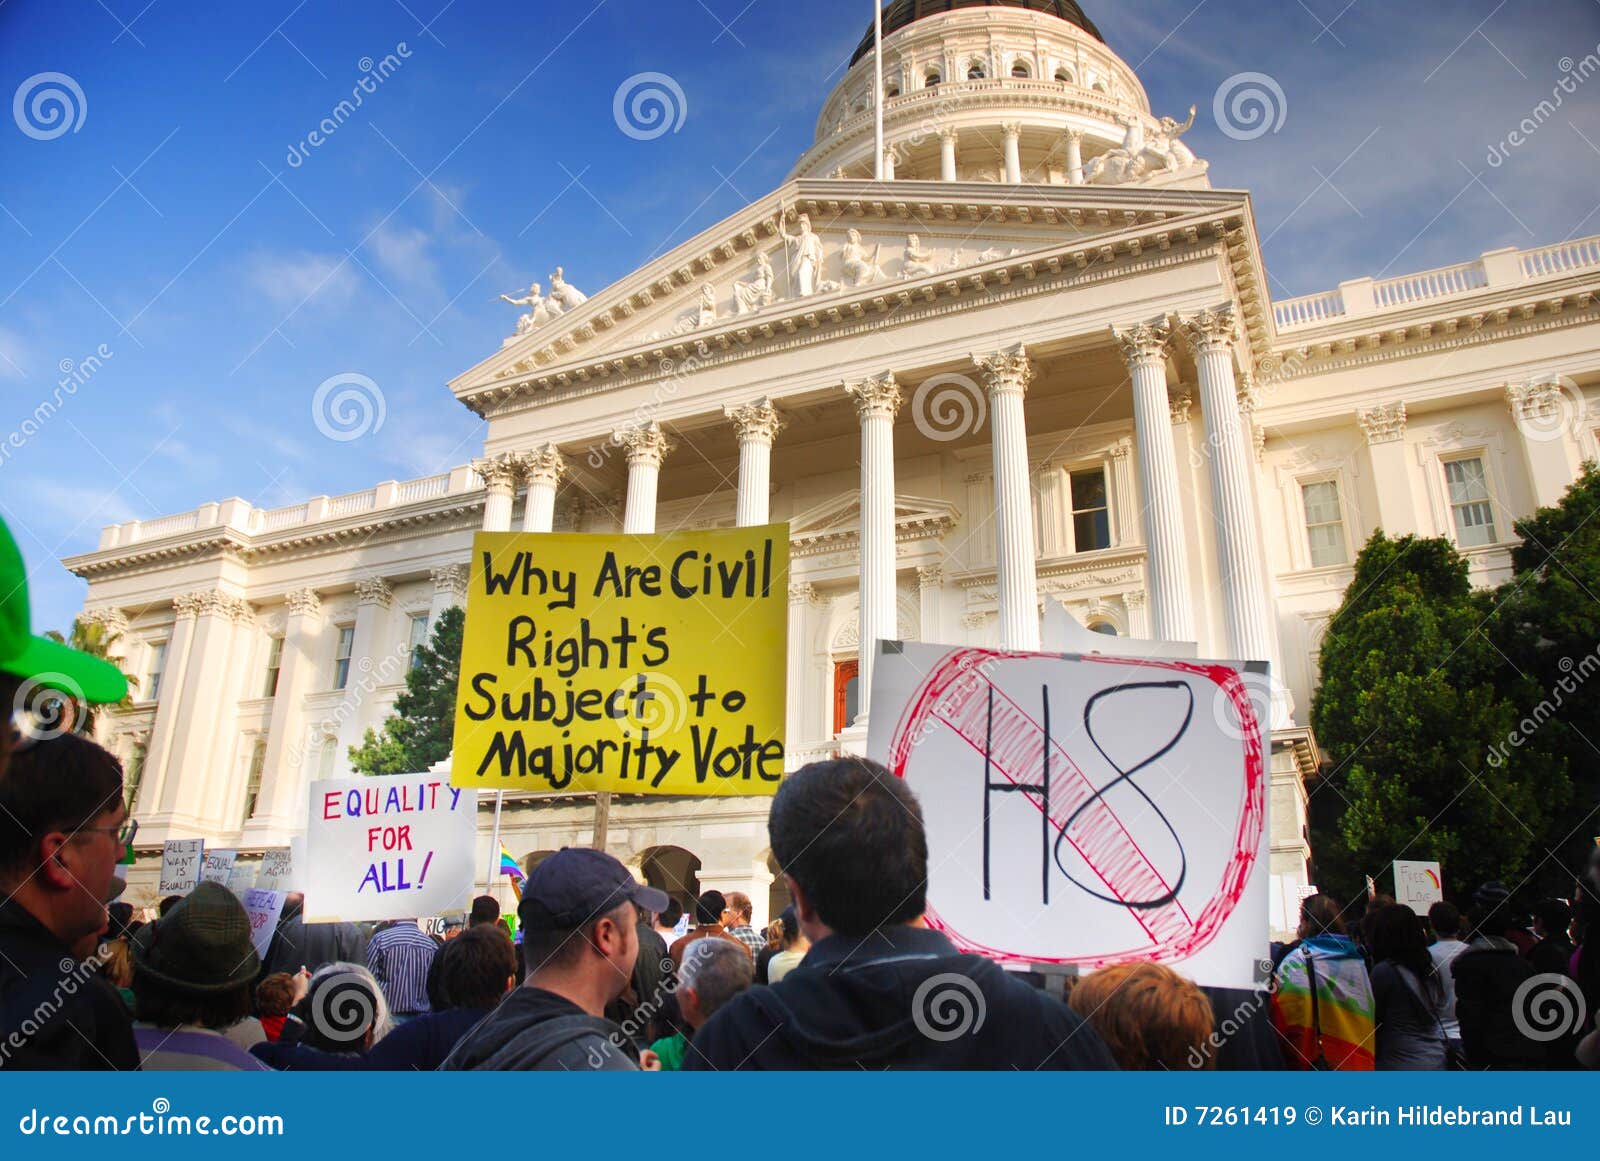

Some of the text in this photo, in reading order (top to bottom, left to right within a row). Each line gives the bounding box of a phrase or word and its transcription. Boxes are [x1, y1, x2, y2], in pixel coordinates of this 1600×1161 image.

[482, 539, 773, 610] Why Are Civil
[464, 672, 746, 727] Subject to
[475, 724, 786, 790] Majority Vote
[323, 782, 461, 820] EQUALITY
[983, 680, 1194, 910] H8
[166, 841, 198, 854] ALL I
[368, 825, 413, 852] FOR
[166, 856, 196, 867] WANT
[175, 867, 186, 877] IS
[357, 851, 434, 893] ALL!
